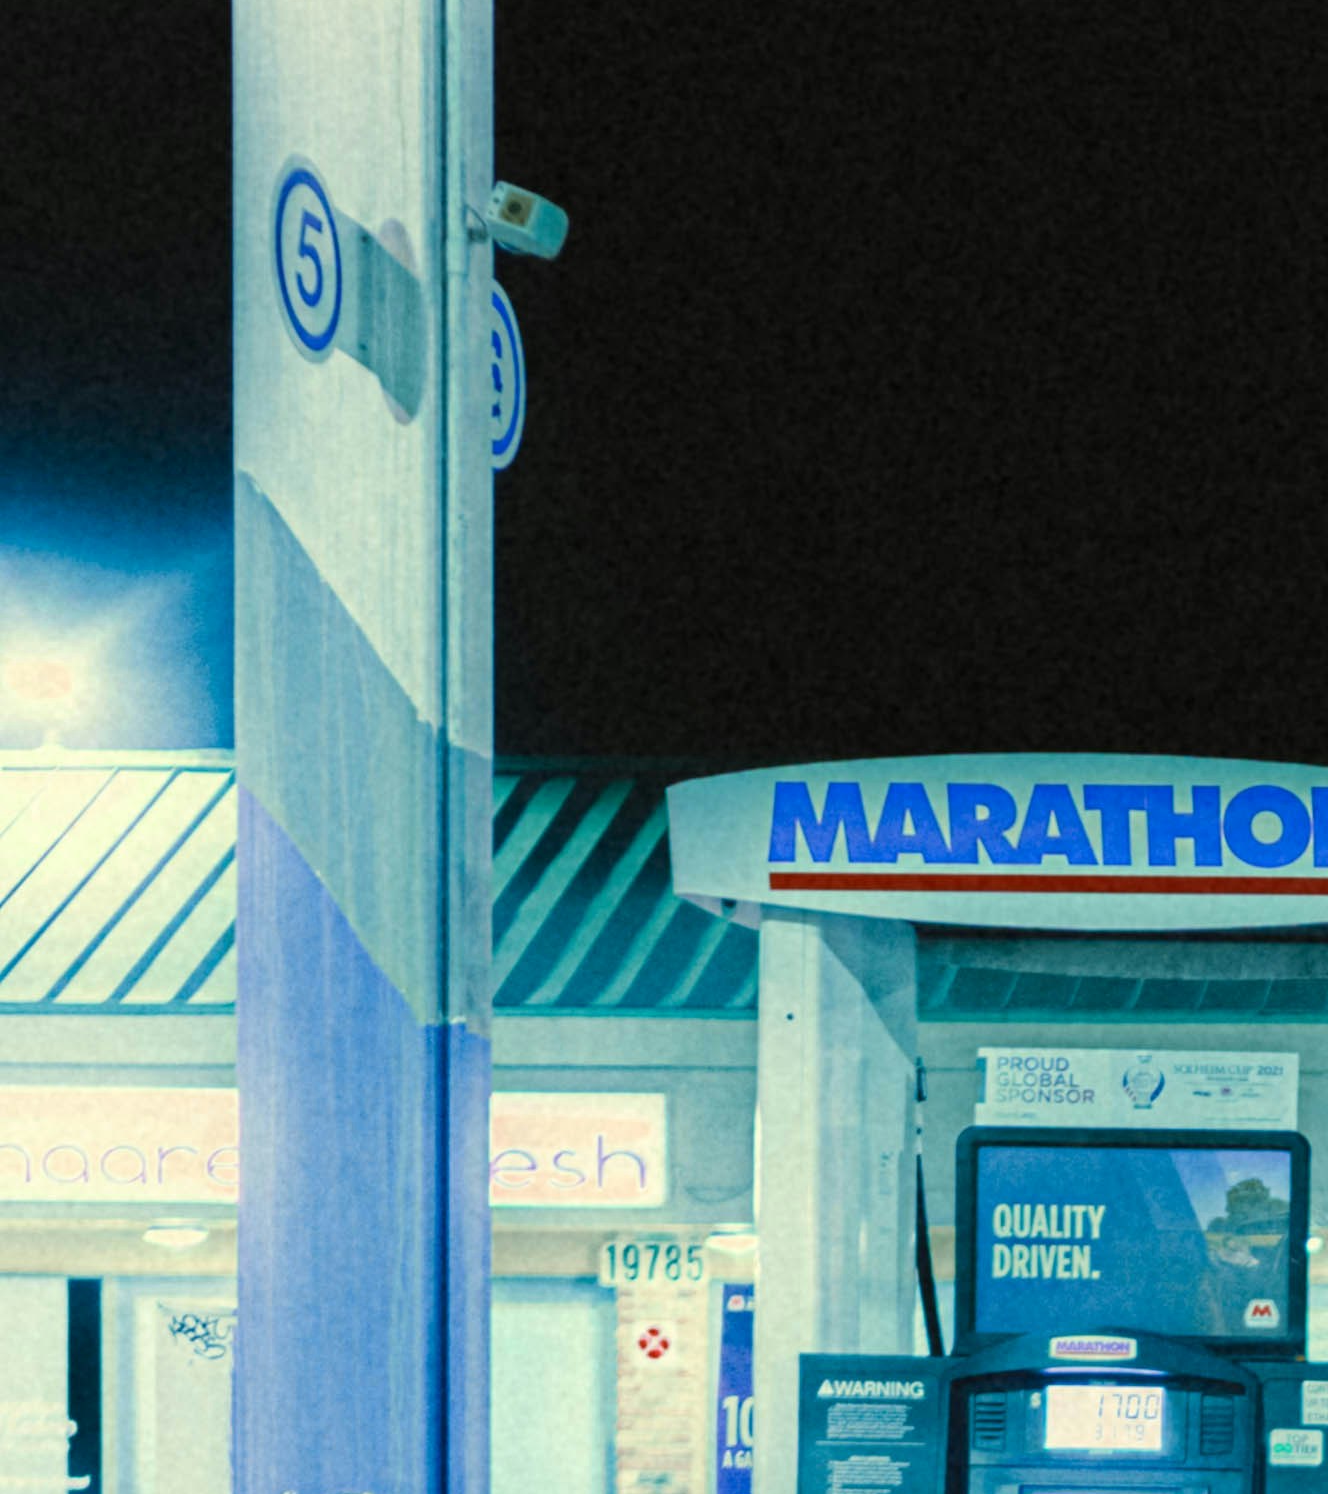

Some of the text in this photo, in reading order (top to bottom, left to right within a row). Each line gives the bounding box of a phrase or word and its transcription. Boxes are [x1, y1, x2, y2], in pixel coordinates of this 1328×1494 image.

[294, 210, 324, 308] 5
[996, 1057, 1070, 1072] PROUD
[996, 1072, 1080, 1088] GLOBAL
[995, 1088, 1095, 1105] SPONSOR
[992, 1203, 1106, 1240] QUALITY
[606, 1243, 704, 1282] 19785
[991, 1243, 1102, 1280] DRIVEN.
[1055, 1340, 1131, 1353] MARATHON
[833, 1380, 925, 1398] WARNING
